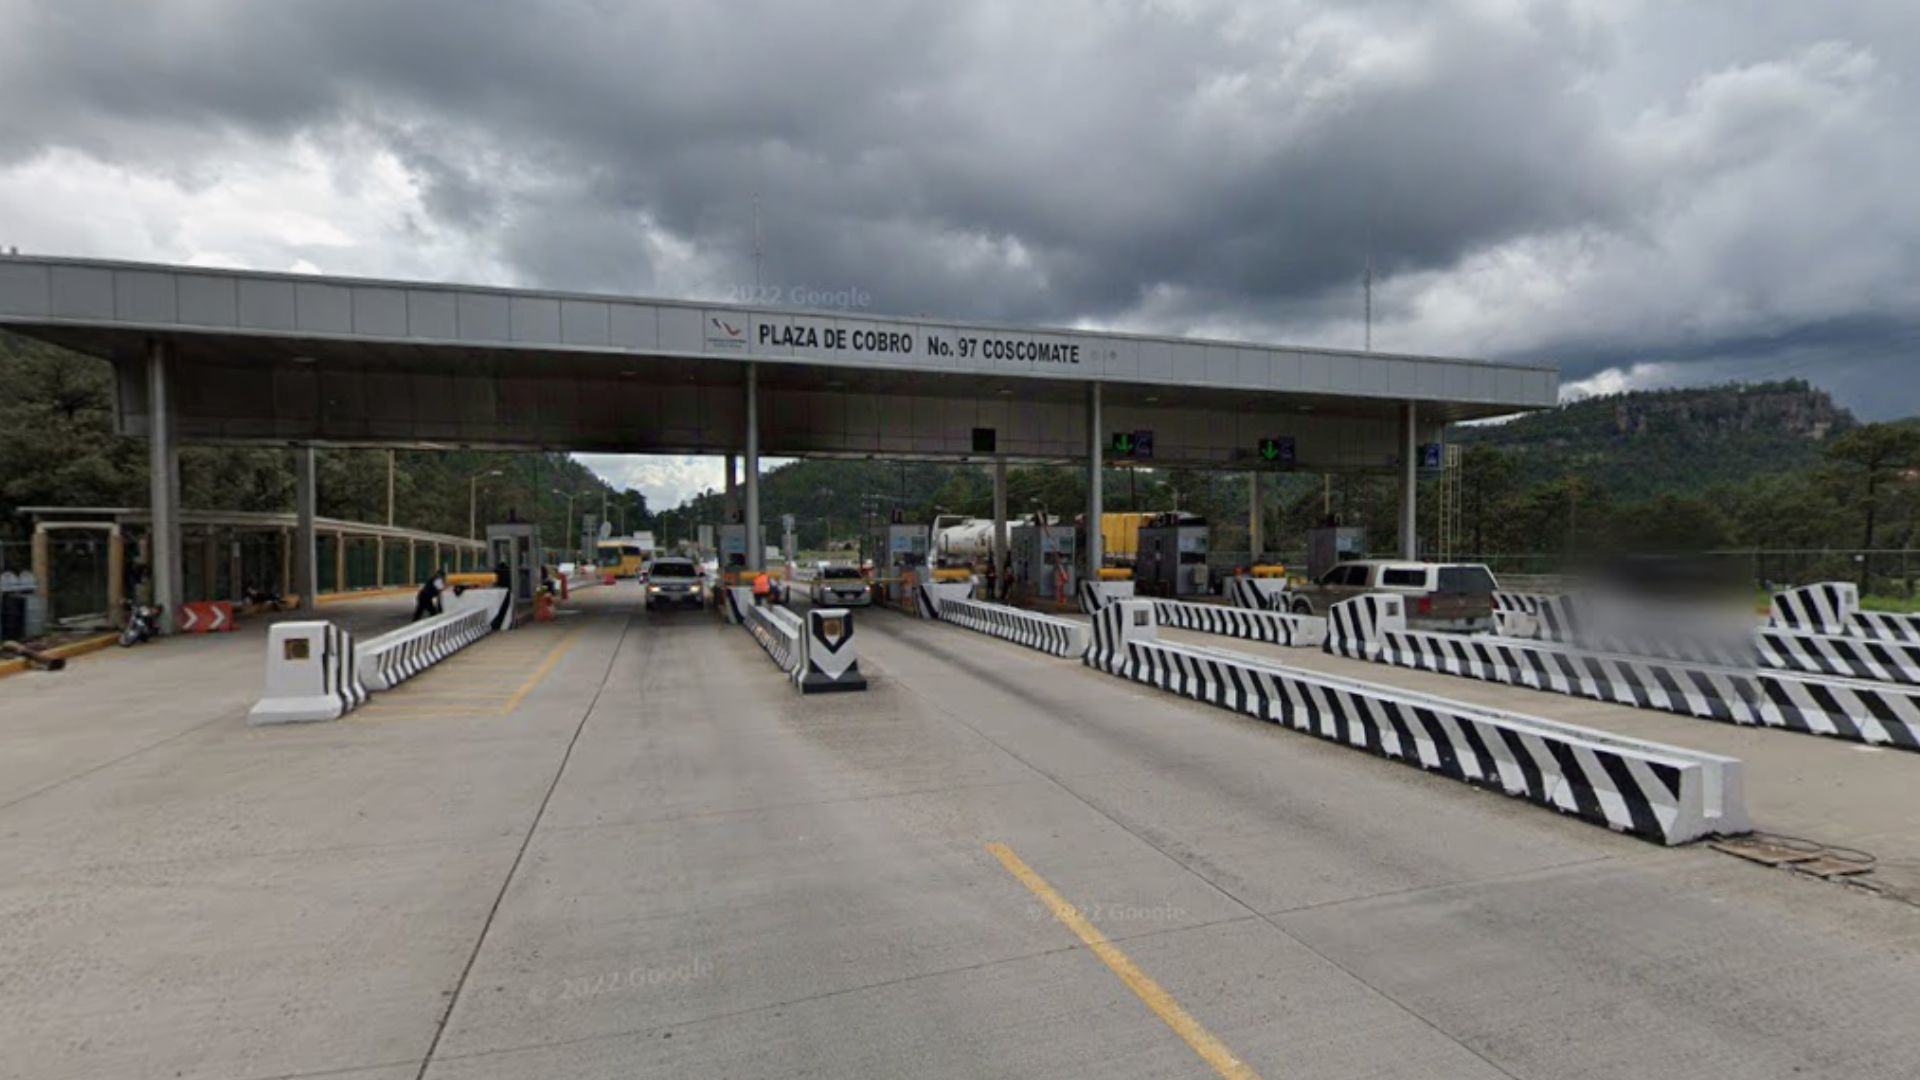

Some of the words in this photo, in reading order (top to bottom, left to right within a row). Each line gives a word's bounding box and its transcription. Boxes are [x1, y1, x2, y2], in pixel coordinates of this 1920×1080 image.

[759, 324, 818, 347] PLAZA
[824, 328, 847, 350] DE
[852, 330, 913, 353] COBRO
[927, 336, 954, 357] No.
[958, 338, 977, 358] 97
[983, 339, 1080, 363] COSCOMATE
